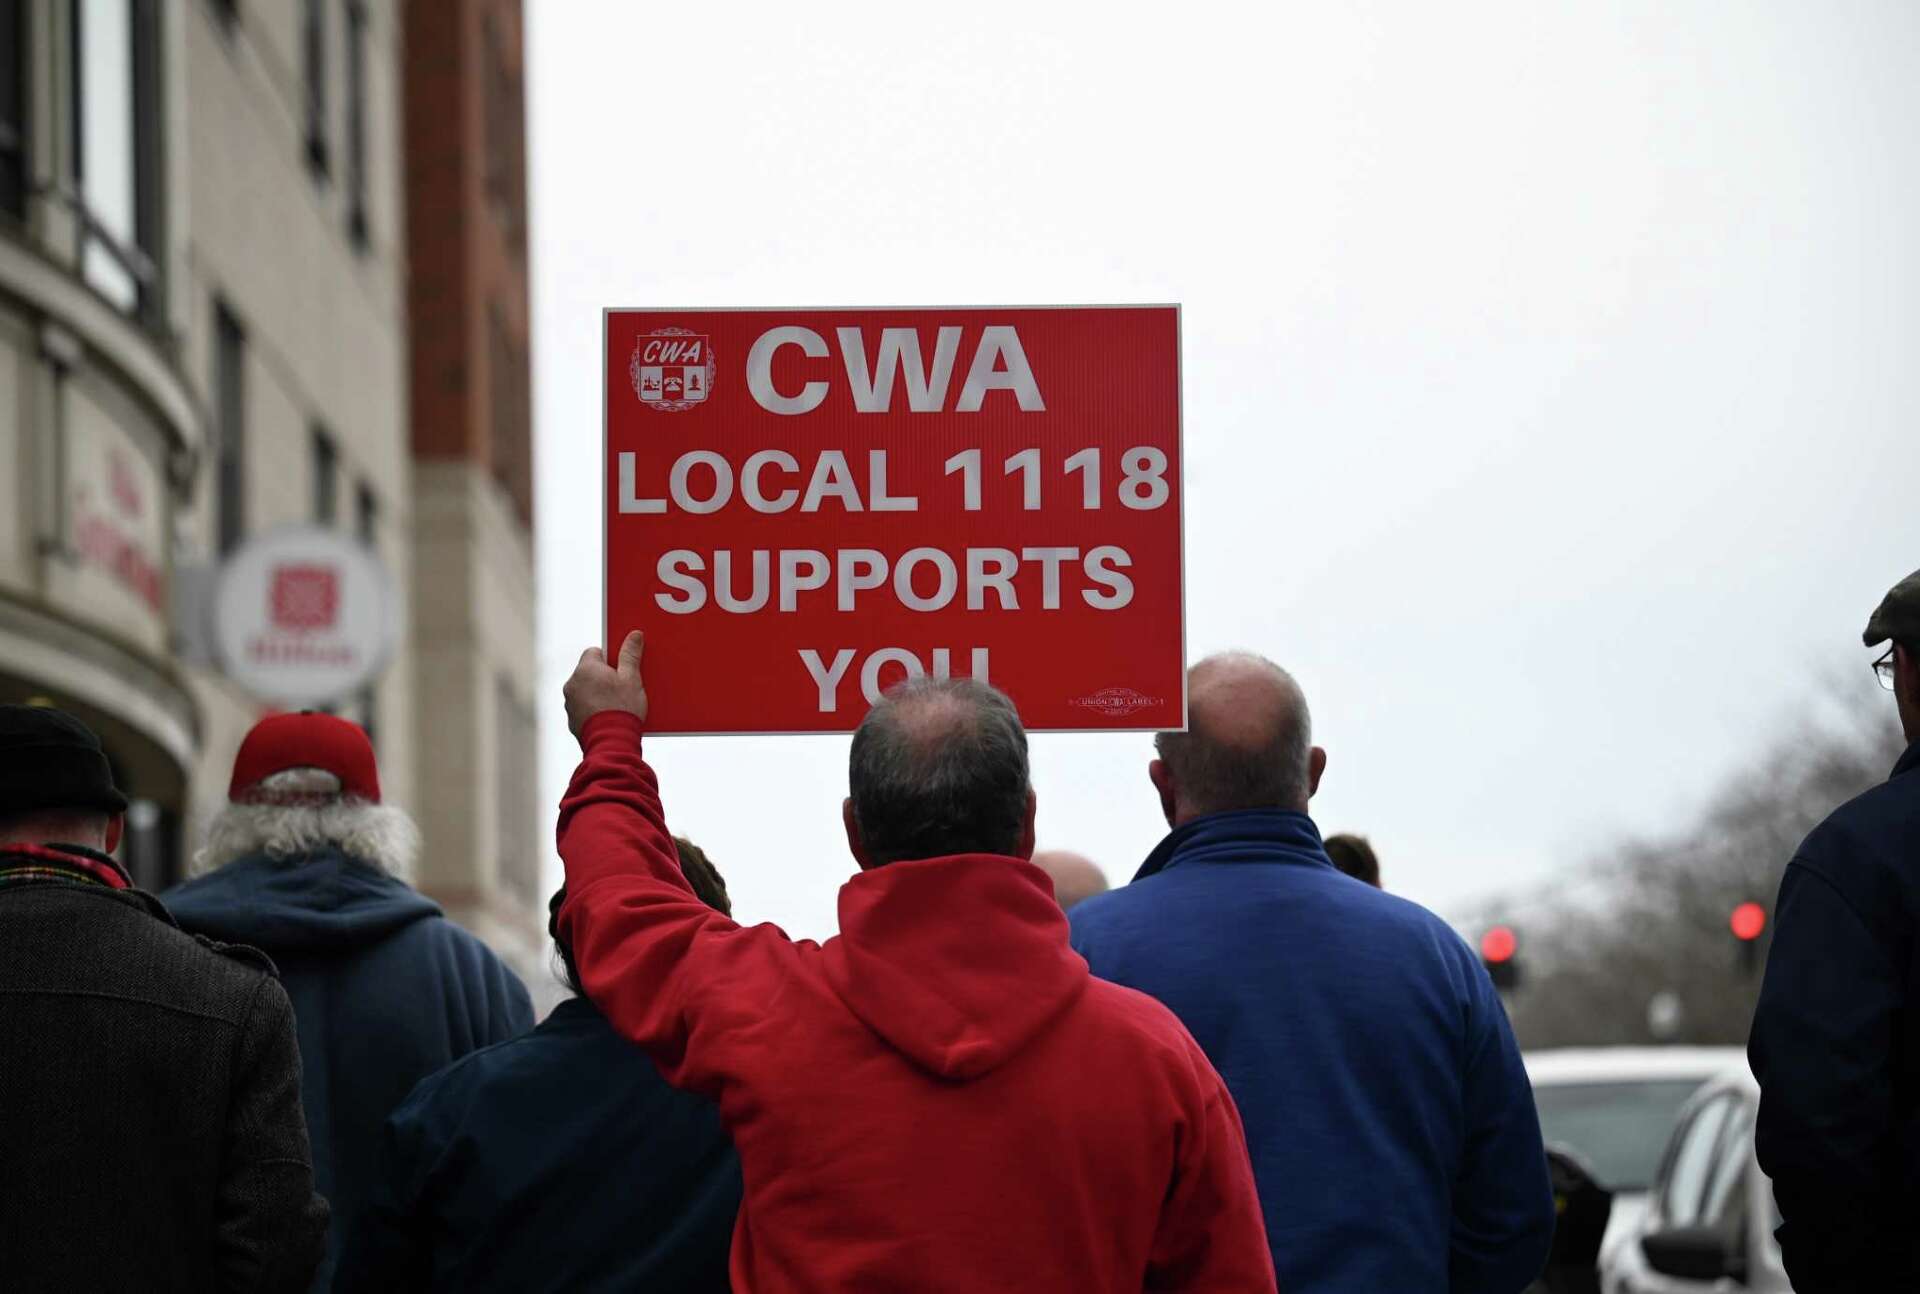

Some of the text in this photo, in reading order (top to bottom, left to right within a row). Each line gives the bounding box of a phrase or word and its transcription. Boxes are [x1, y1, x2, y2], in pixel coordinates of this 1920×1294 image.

[643, 340, 702, 364] CWA
[746, 325, 1046, 415] CWA
[618, 446, 1170, 514] LOCAL 1118
[654, 545, 1134, 614] SUPPORTS
